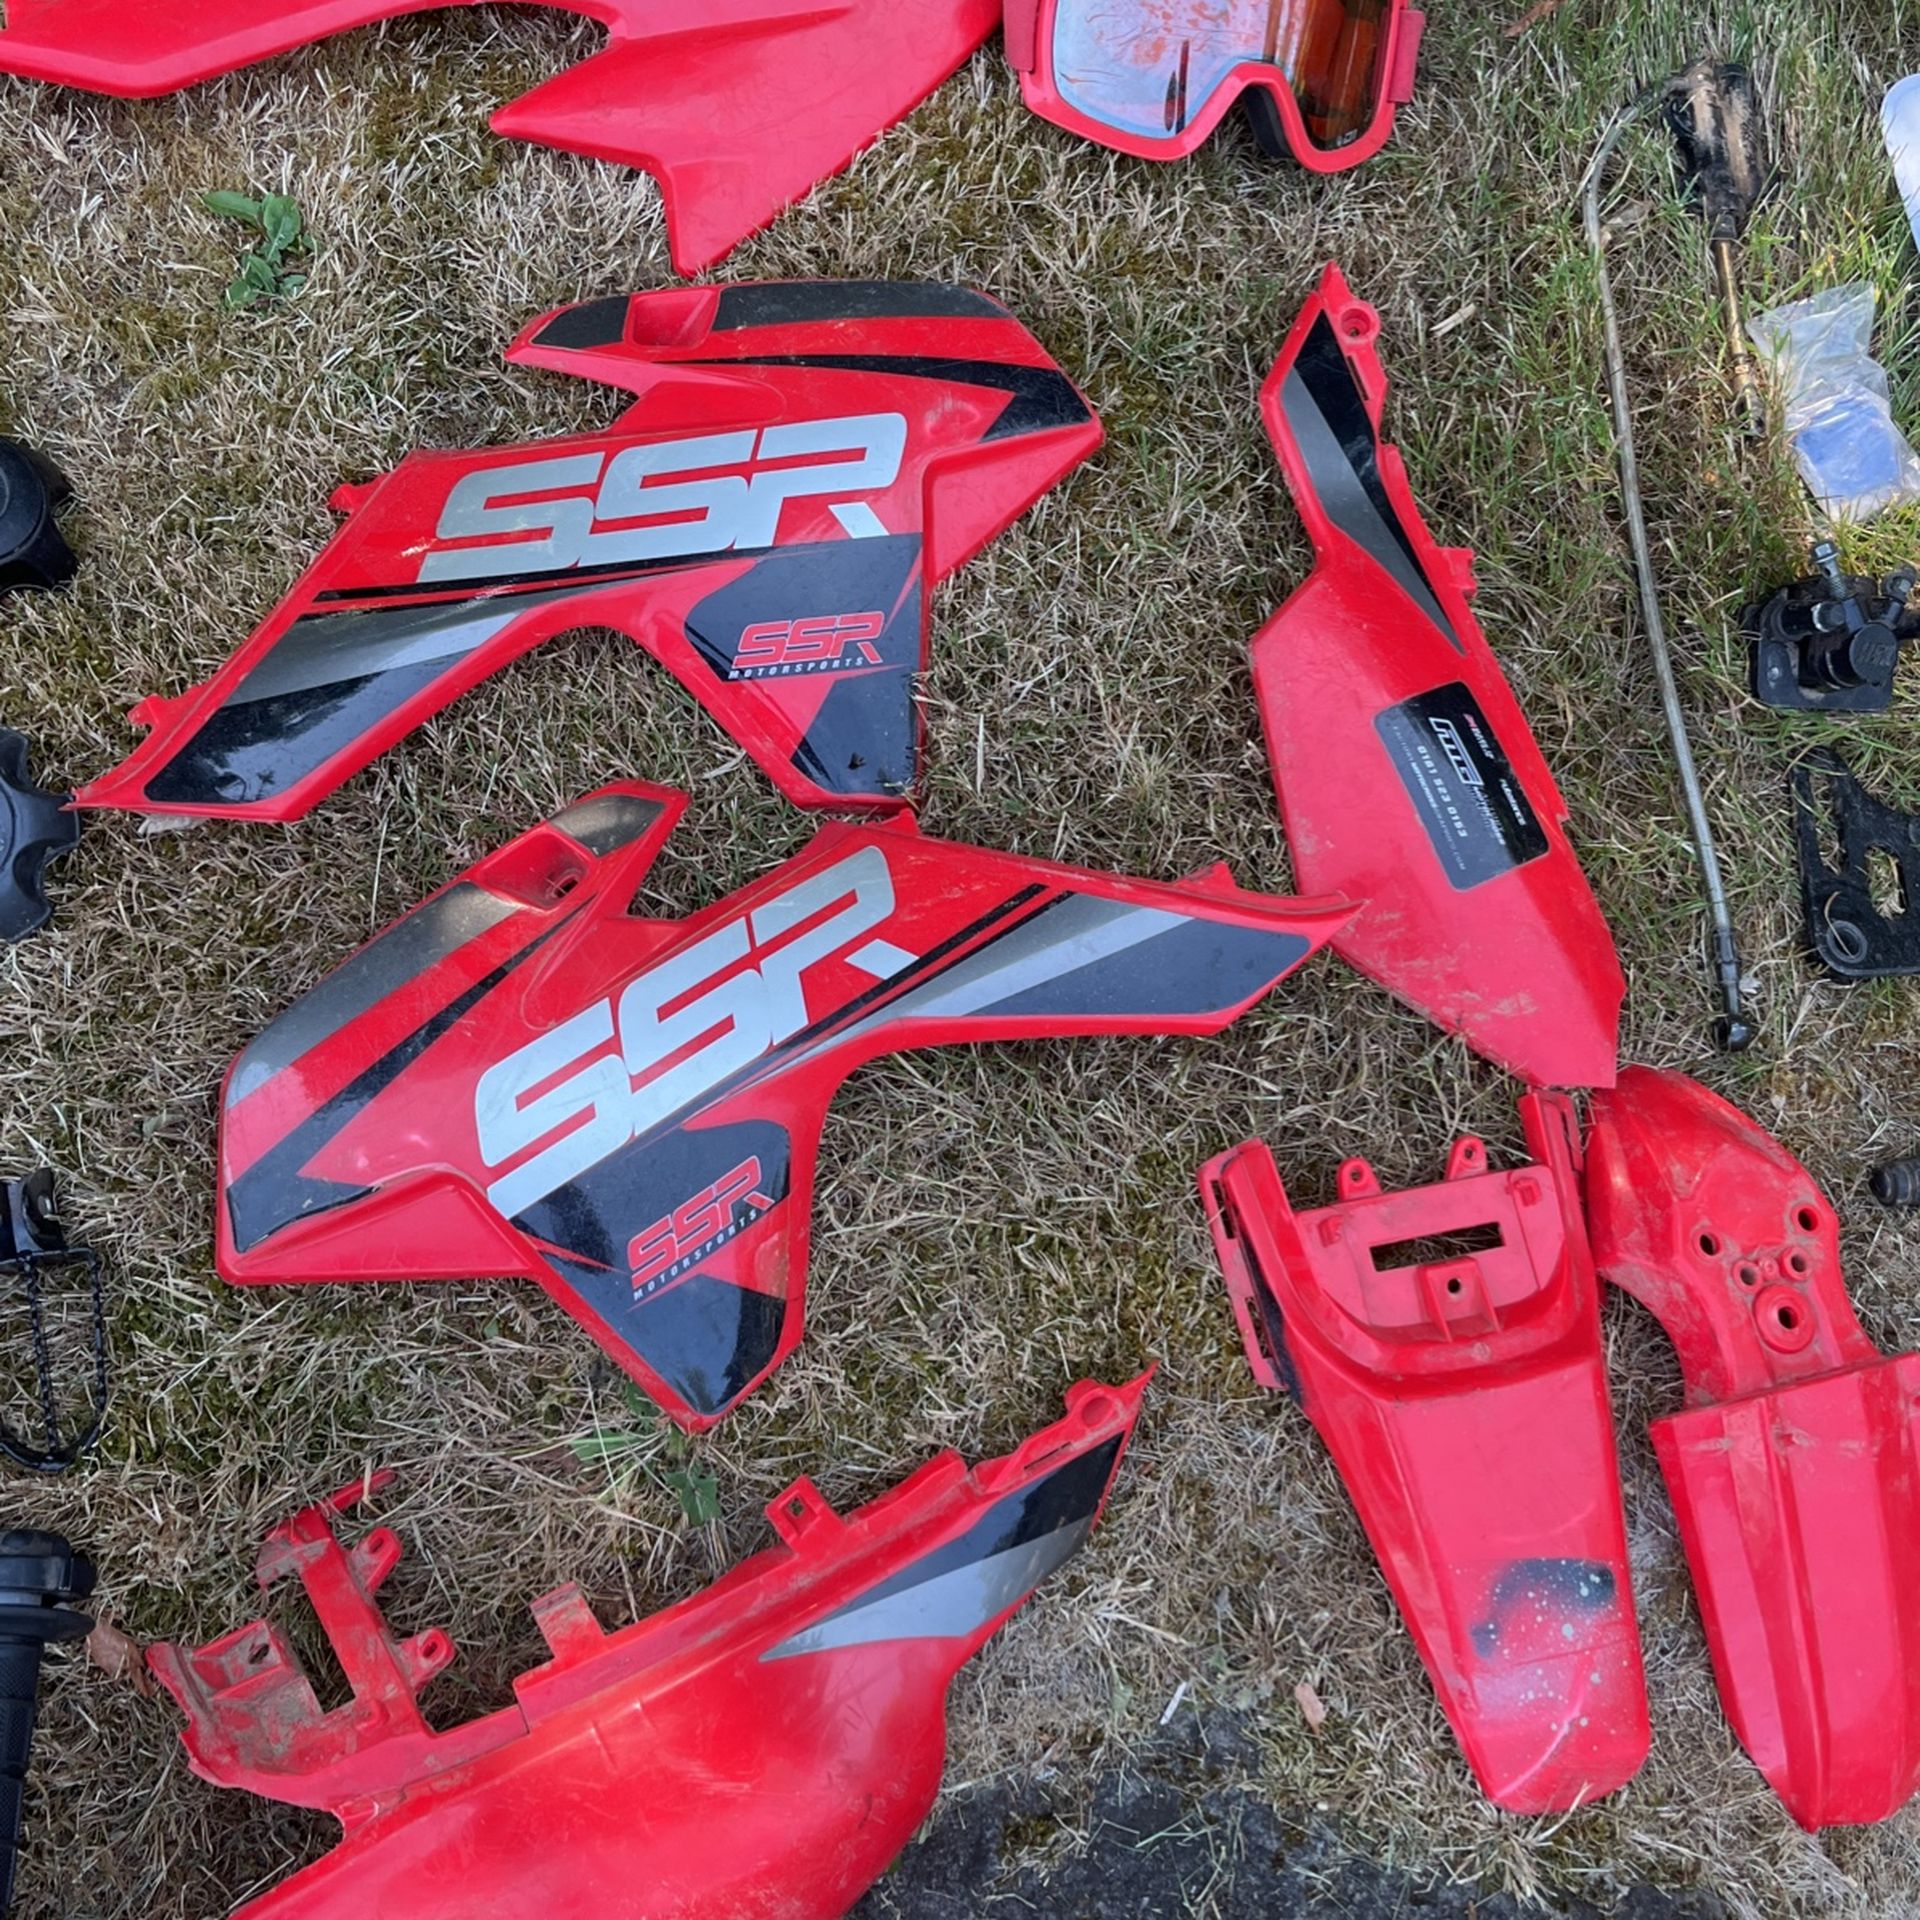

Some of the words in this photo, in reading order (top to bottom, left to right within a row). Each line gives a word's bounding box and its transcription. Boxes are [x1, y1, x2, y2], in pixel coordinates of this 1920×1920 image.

[417, 413, 907, 583] SSR
[728, 656, 864, 679] MOTORSPORTS
[732, 611, 884, 669] SSR
[475, 845, 918, 1220] SSR
[627, 1155, 775, 1290] SSR
[633, 1208, 758, 1301] MOTORSPORTS
